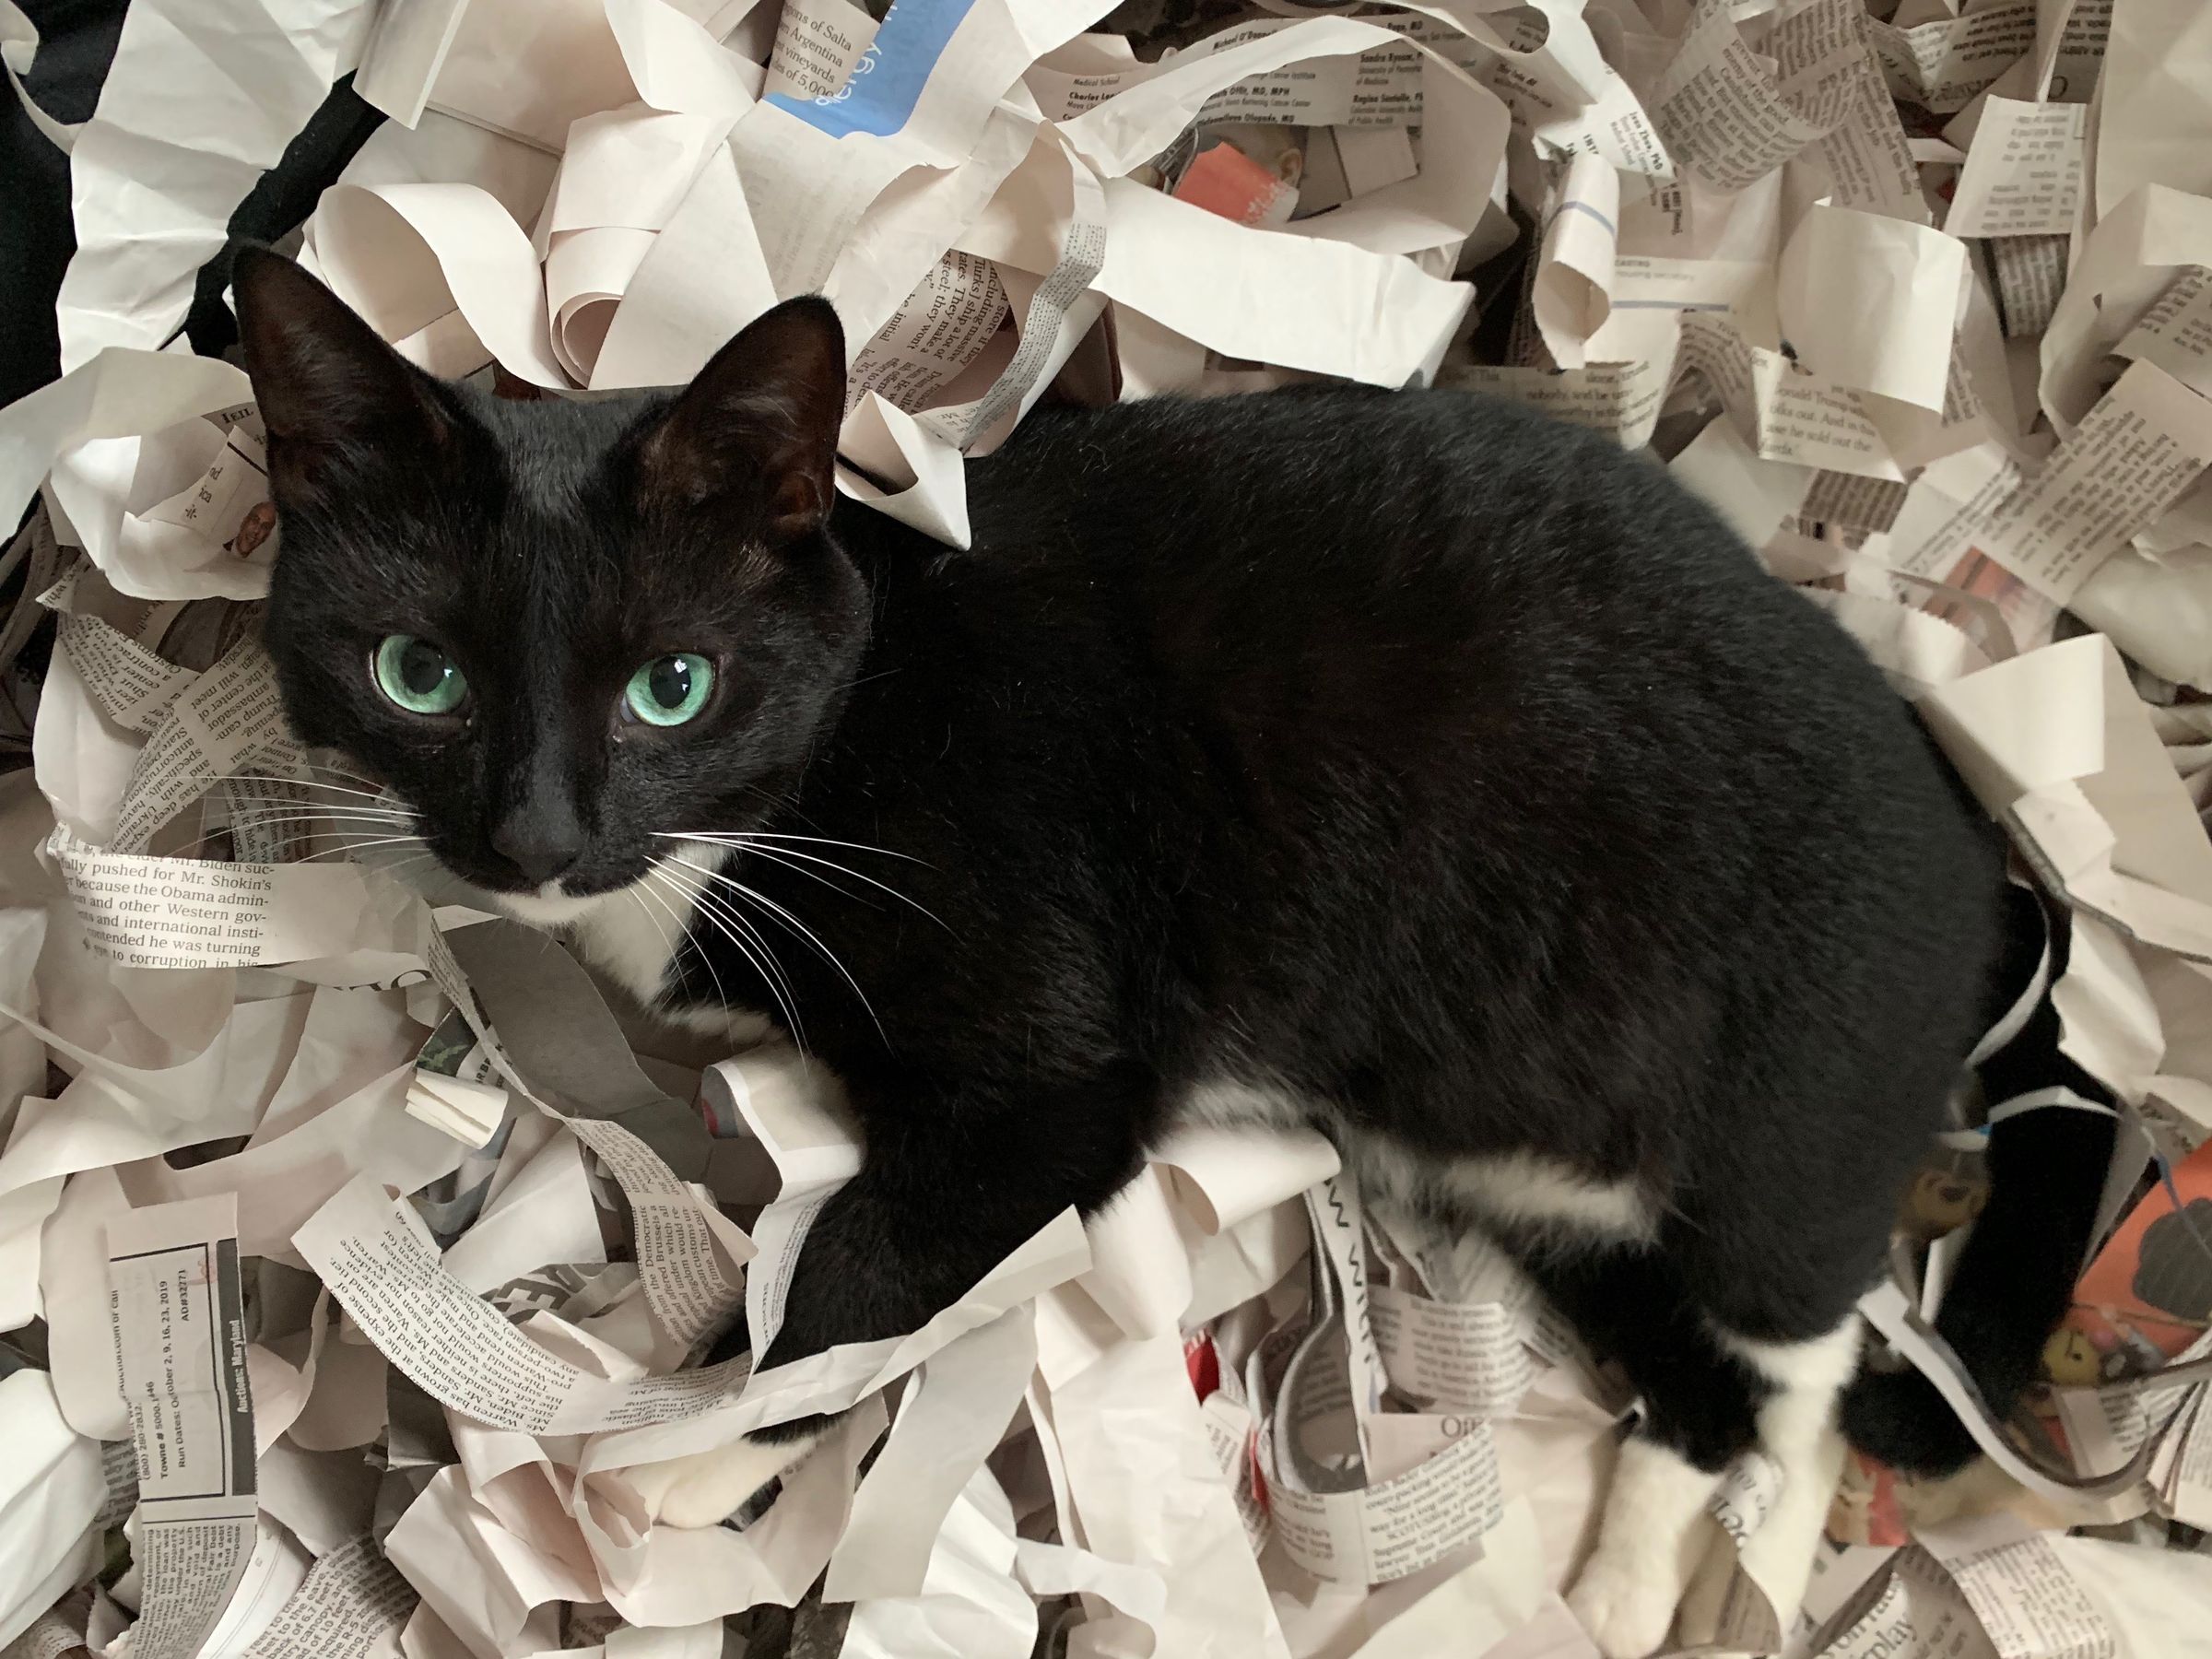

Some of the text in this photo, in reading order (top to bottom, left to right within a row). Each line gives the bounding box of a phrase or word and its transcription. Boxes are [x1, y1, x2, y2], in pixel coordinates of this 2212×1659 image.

[789, 26, 845, 68] Argentina
[809, 17, 853, 52] of Salta
[782, 45, 838, 84] vineyards
[783, 65, 799, 81] of
[937, 259, 950, 291] steel;
[926, 295, 946, 322] they
[945, 288, 965, 319] They
[957, 300, 975, 324] ship
[878, 310, 907, 343] initial
[926, 321, 948, 347] make
[942, 334, 959, 347] lot
[947, 325, 978, 361] massive
[112, 641, 160, 678] contract
[188, 669, 241, 711] will meet
[195, 669, 264, 723] the center of
[205, 680, 271, 735] ambassador
[213, 690, 278, 744] Trump cam-
[229, 724, 277, 765] by what
[125, 735, 195, 802] anticorruption
[108, 757, 211, 853] and with Ukrainian
[149, 782, 199, 827] has deep
[92, 860, 147, 881] pushed
[153, 867, 175, 881] for
[181, 870, 206, 884] Mr.
[76, 877, 269, 908] because the Obama admin-
[89, 895, 266, 926] and other Western gov-
[96, 912, 264, 939] and international insti-
[112, 949, 206, 971] to corruption
[149, 935, 261, 957] he was turning
[652, 1215, 665, 1261] Brussels
[658, 1205, 684, 1288] under which all
[686, 1223, 701, 1267] customs
[326, 1256, 349, 1279] tier.
[639, 1205, 672, 1313] from the Democratic
[674, 1223, 703, 1300] Kingdom would
[334, 1279, 349, 1296] of
[347, 1277, 383, 1314] second
[336, 1239, 558, 1414] the left, there is neither reason nor evidence
[347, 1293, 387, 1337] expense
[379, 1313, 399, 1334] the
[345, 1259, 553, 1419] since Mr. Sanders and Ms. Warren are on
[382, 1336, 402, 1357] the
[395, 1331, 418, 1354] and
[159, 1280, 185, 1467] Run Dates: October 2, 9, 16, 23, 2019
[228, 1319, 247, 1413] Auctions: Maryland
[401, 1353, 414, 1366] at
[416, 1351, 461, 1391] Sanders,
[412, 1364, 450, 1394] grown
[462, 1386, 483, 1404] Mr.
[448, 1392, 470, 1408] has
[472, 1405, 518, 1429] Warren
[486, 1398, 524, 1420] Biden,
[157, 1432, 164, 1441] #
[139, 1453, 150, 1480] (800)
[159, 1442, 168, 1478] Towne
[277, 1568, 329, 1635] to the eave.
[289, 1621, 304, 1636] of
[300, 1606, 317, 1623] 6.7
[312, 1580, 332, 1606] feet
[298, 1600, 337, 1644] canopy.
[307, 1593, 350, 1648] of 10 feet
[315, 1605, 357, 1656] required,
